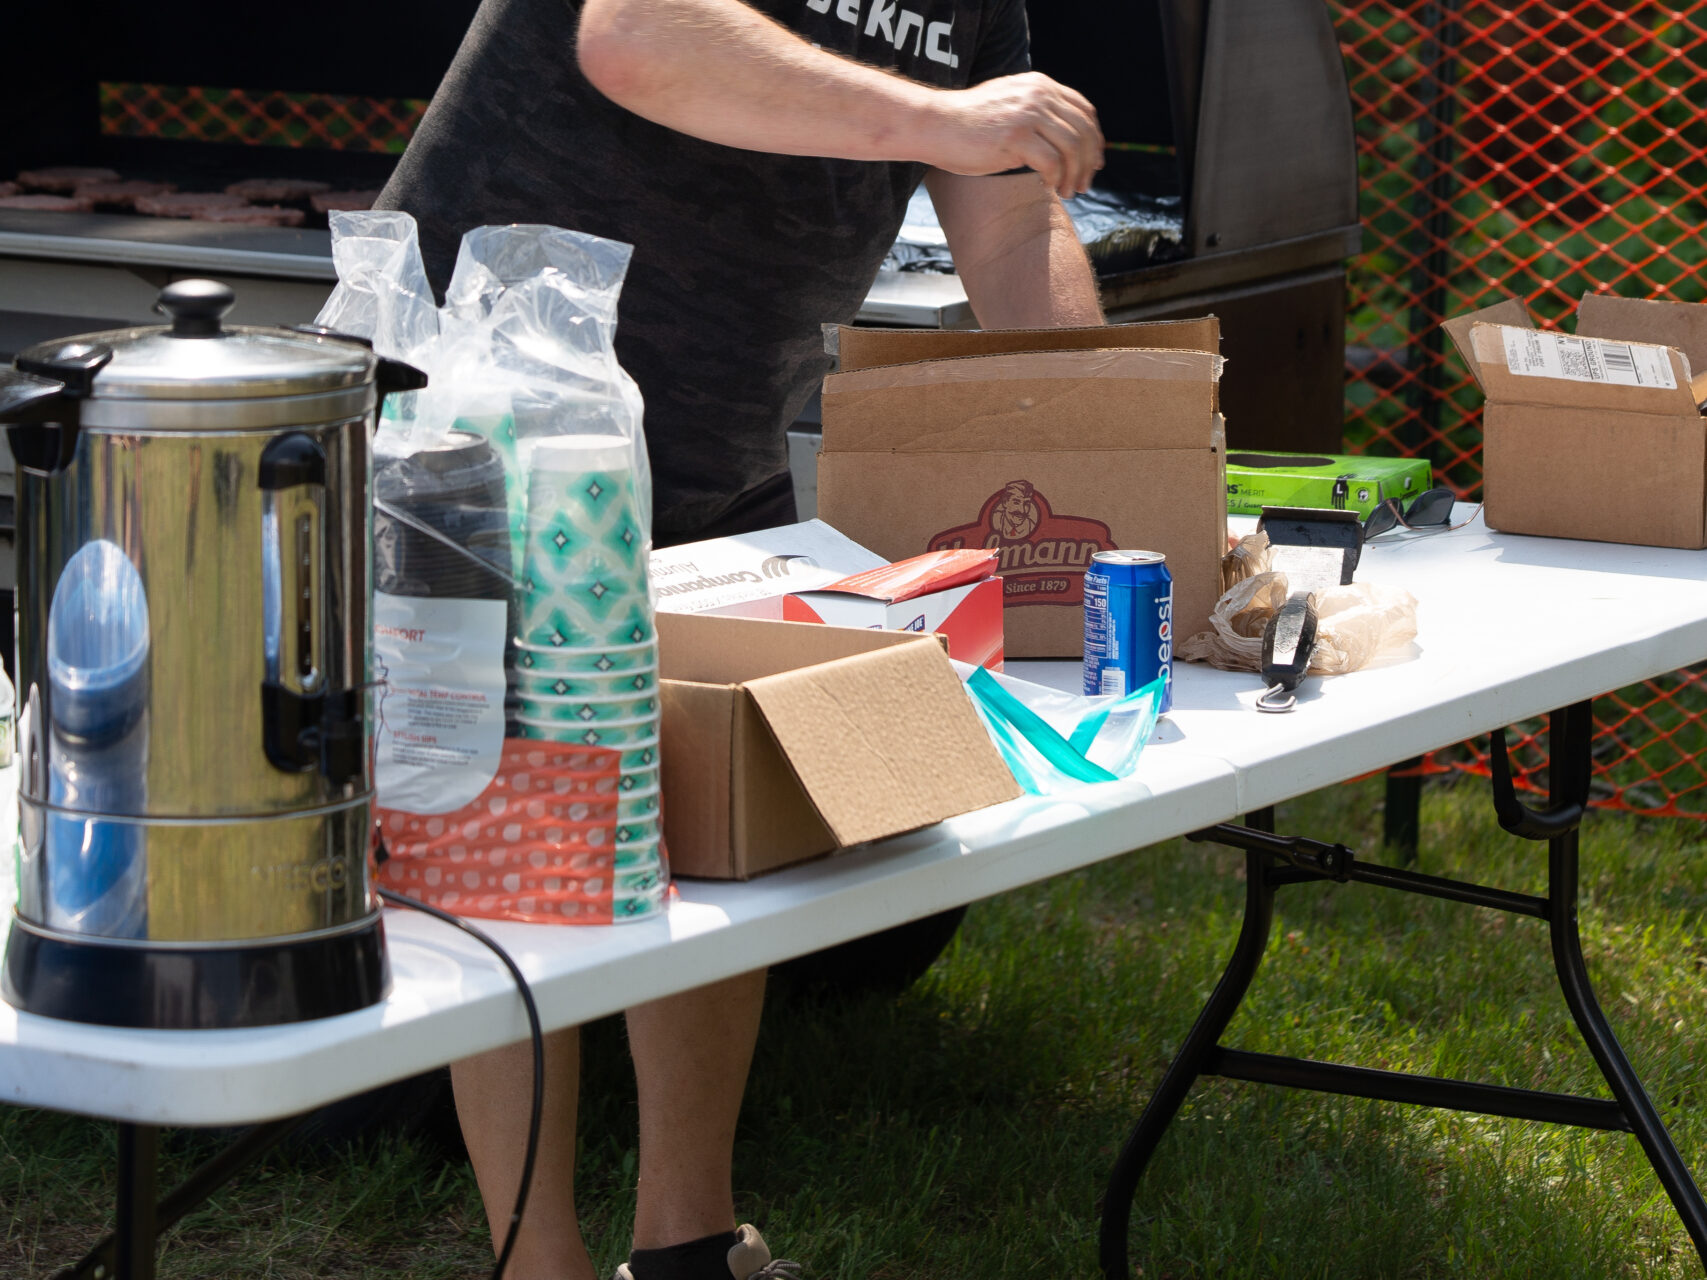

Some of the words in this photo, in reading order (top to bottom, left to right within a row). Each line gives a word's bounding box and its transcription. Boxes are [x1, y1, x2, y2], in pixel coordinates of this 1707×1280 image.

[1585, 340, 1597, 366] GROUND
[1592, 367, 1601, 380] UPS
[1240, 489, 1265, 497] MERIT
[1337, 483, 1344, 495] L
[1006, 583, 1036, 595] Since
[1040, 580, 1067, 593] 1879
[1094, 597, 1107, 608] 150
[1154, 595, 1173, 684] pepsi
